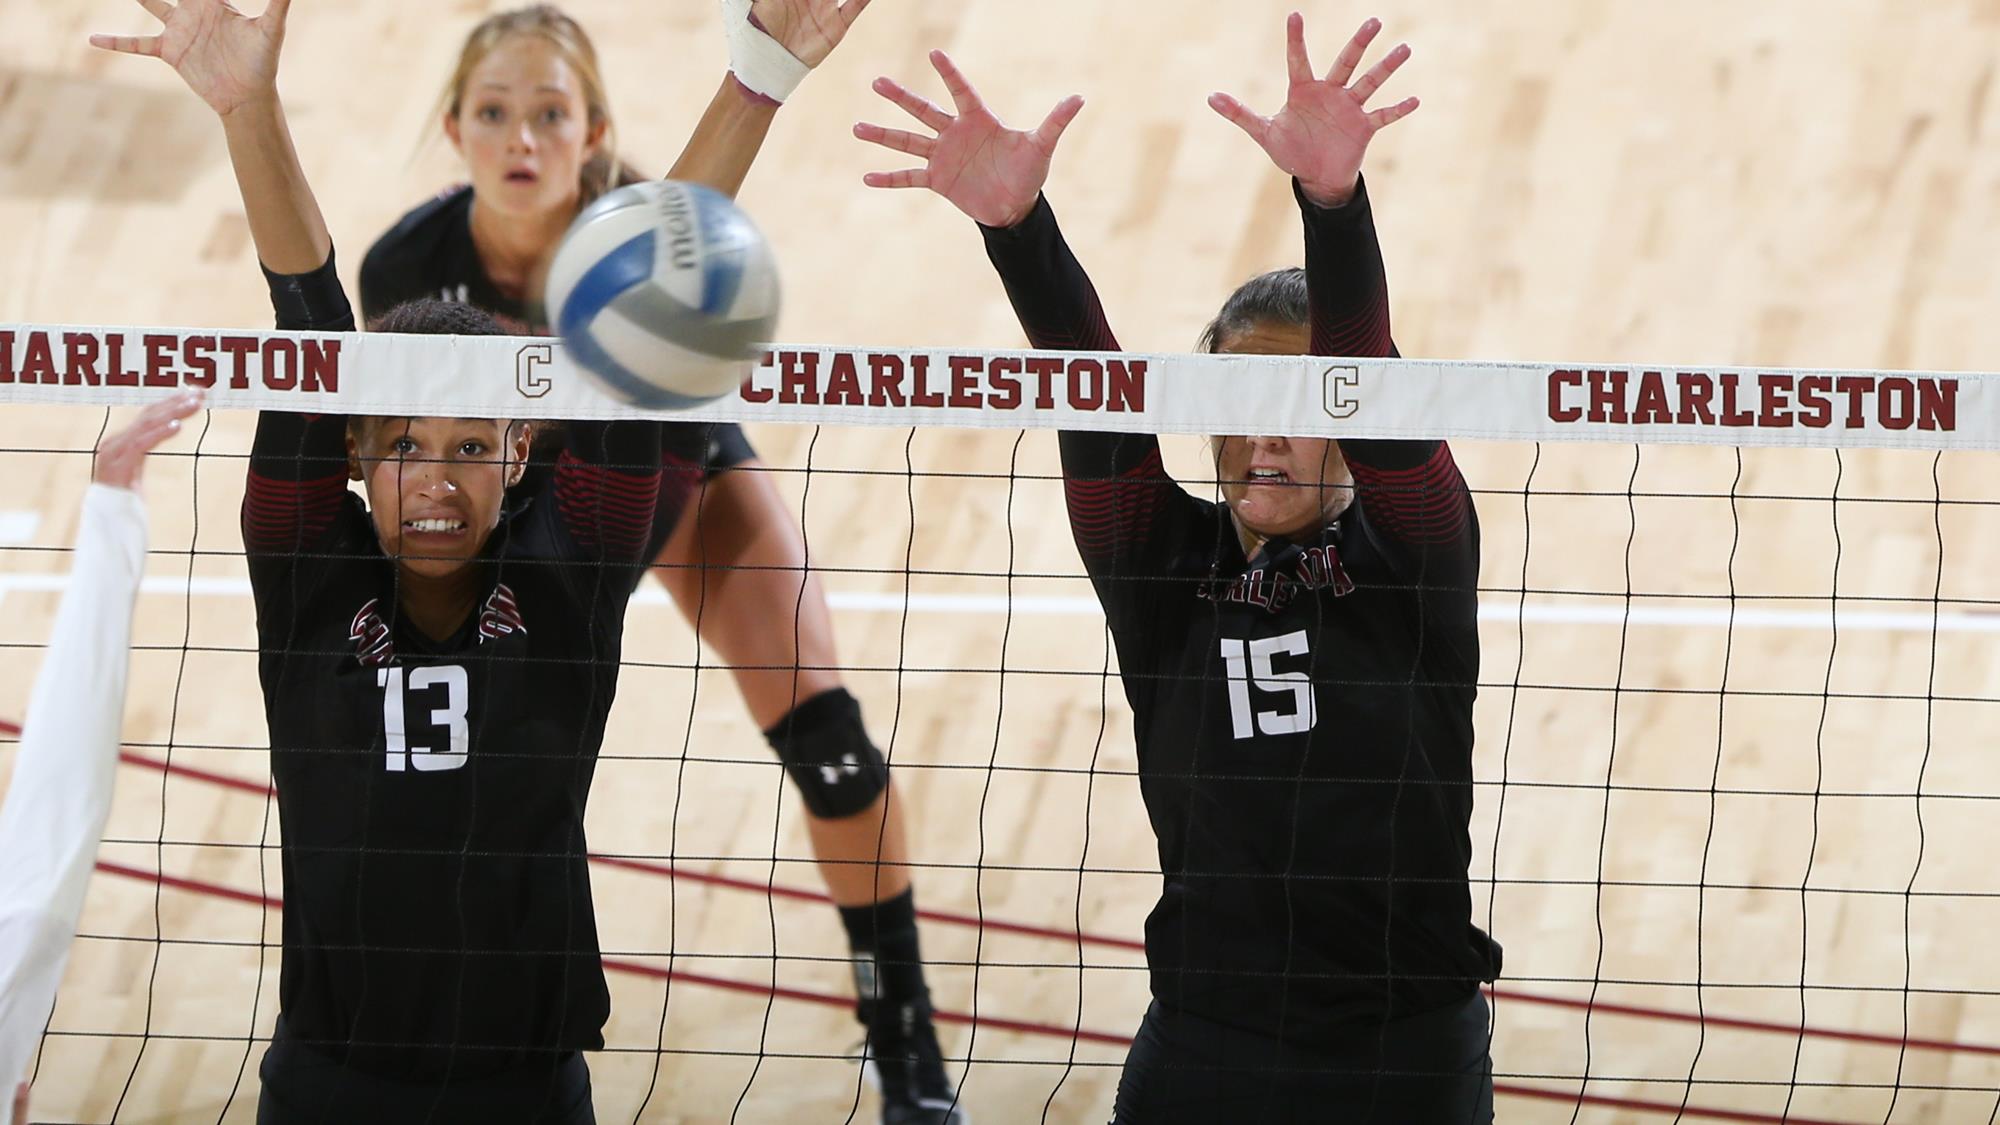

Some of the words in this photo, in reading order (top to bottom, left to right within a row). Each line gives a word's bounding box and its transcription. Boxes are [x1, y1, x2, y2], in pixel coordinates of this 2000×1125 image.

[516, 344, 552, 398] C
[739, 350, 1148, 413] CHARLESTON
[1323, 365, 1359, 419] C
[1547, 369, 1958, 432] CHARLESTON
[1220, 629, 1318, 740] 15
[376, 664, 469, 772] 13
